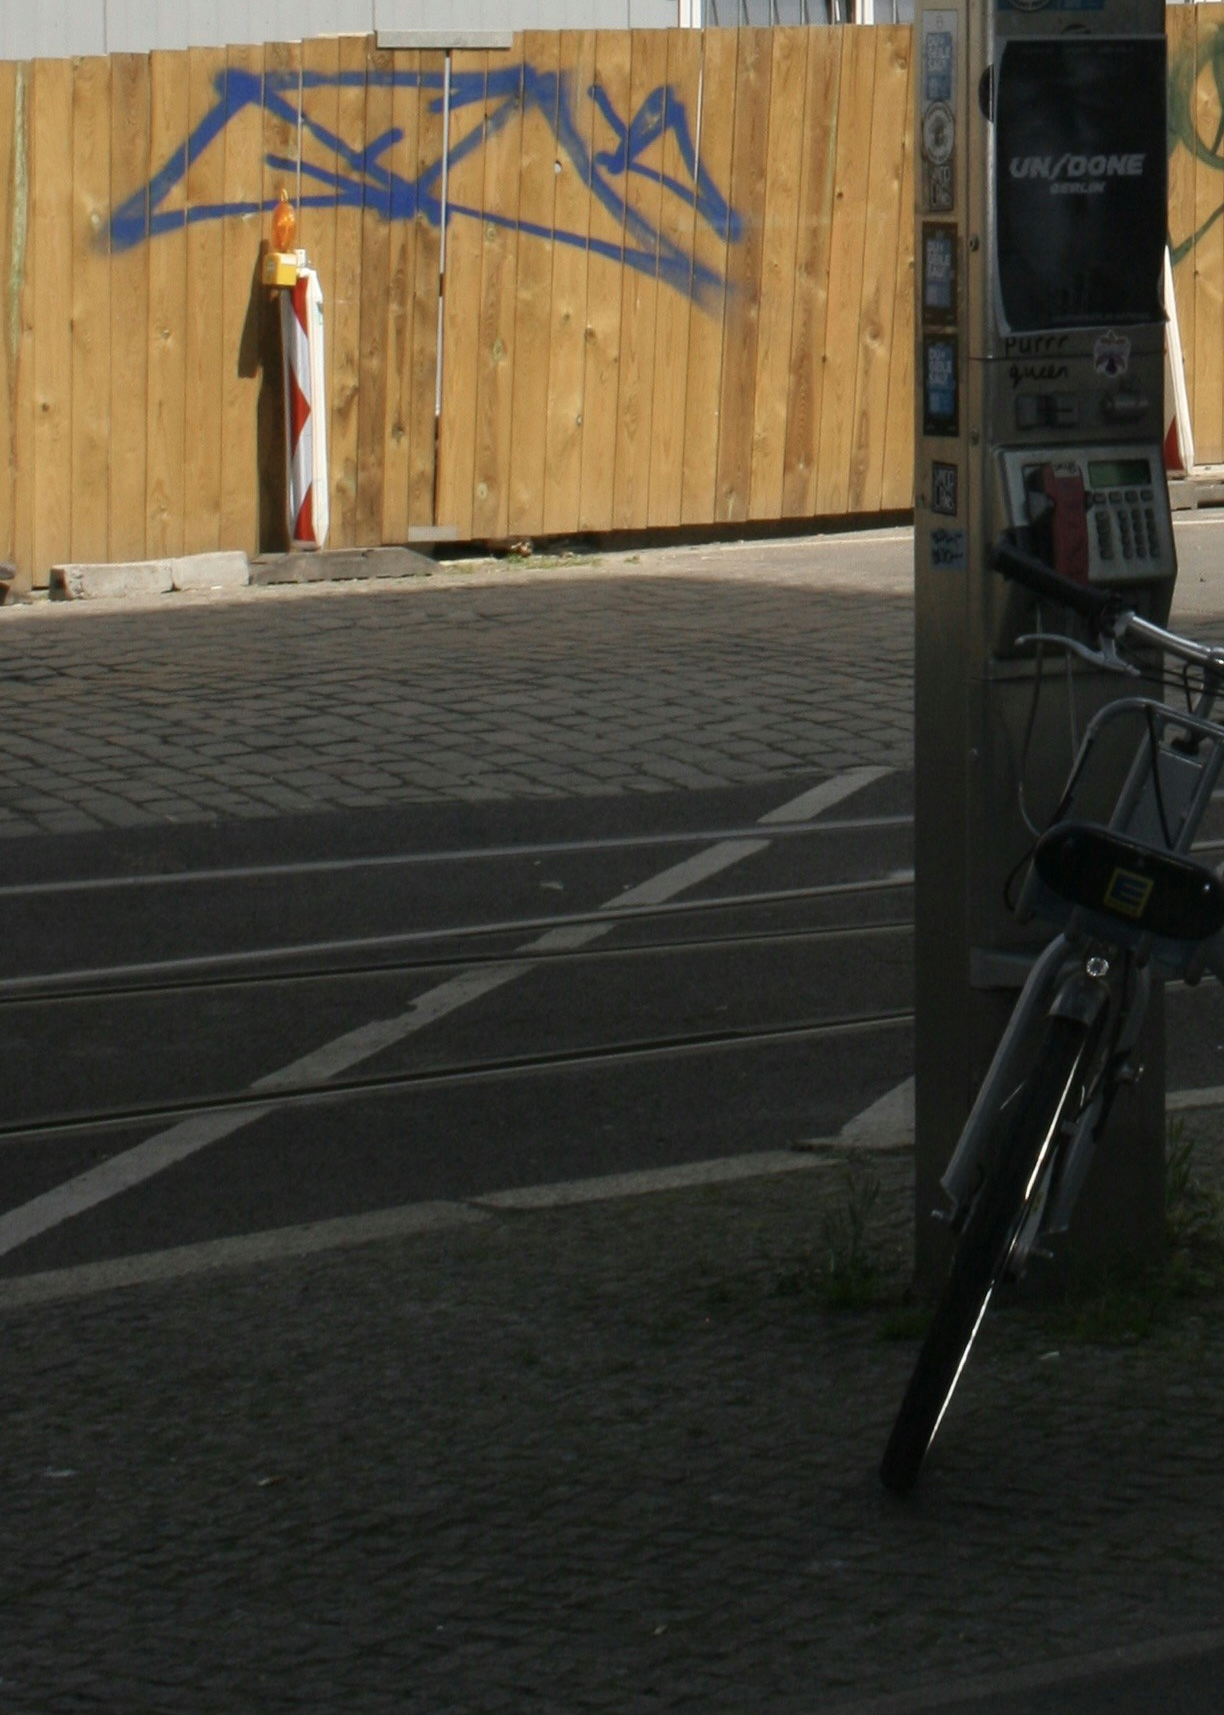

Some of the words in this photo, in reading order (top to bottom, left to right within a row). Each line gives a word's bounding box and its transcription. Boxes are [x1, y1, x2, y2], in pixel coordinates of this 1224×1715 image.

[1010, 153, 1147, 180] UN/DONE
[1049, 182, 1106, 194] BERLIN
[1005, 336, 1069, 358] purrr
[1009, 364, 1069, 388] queen
